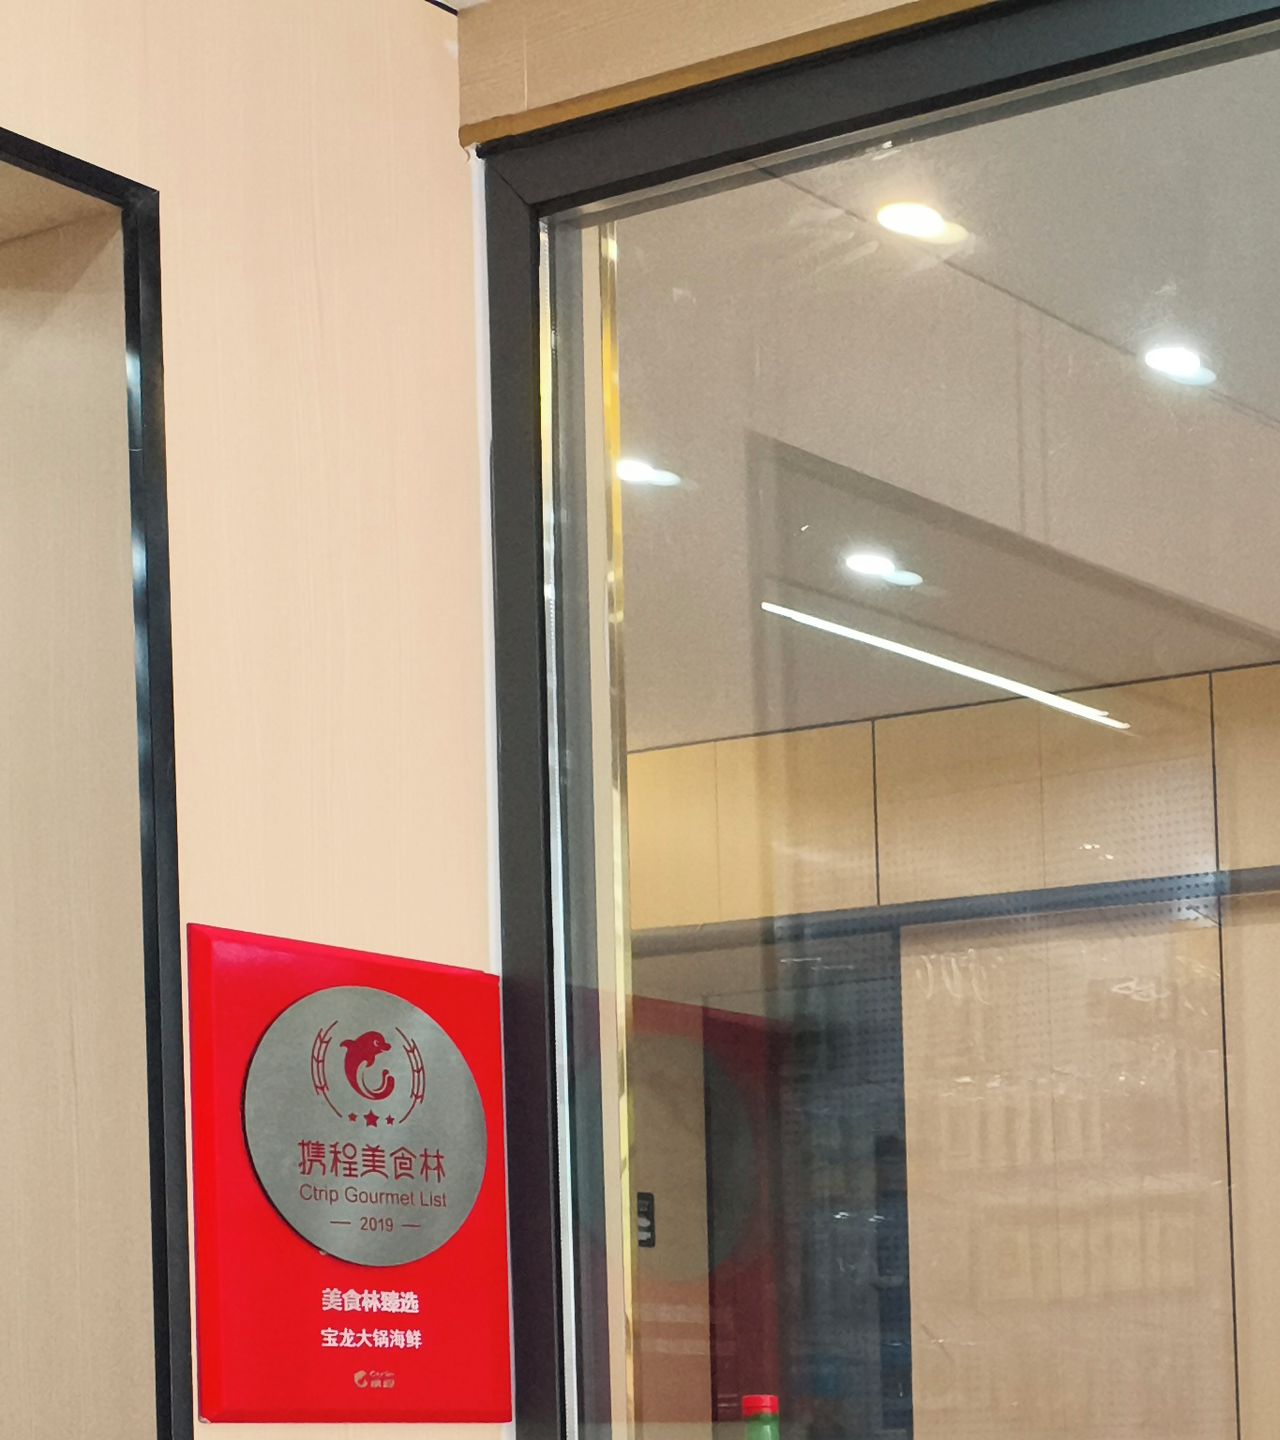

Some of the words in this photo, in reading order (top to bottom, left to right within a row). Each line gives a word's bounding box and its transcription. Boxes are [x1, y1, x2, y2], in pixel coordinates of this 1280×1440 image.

[298, 1139, 446, 1183] 携程美食林
[300, 1183, 339, 1205] Ctrip
[345, 1186, 415, 1205] Gourmet
[420, 1191, 447, 1208] List
[360, 1216, 394, 1232] 2019
[321, 1288, 420, 1314] 美食林臻选
[320, 1327, 423, 1350] 宝龙大锅海鲜
